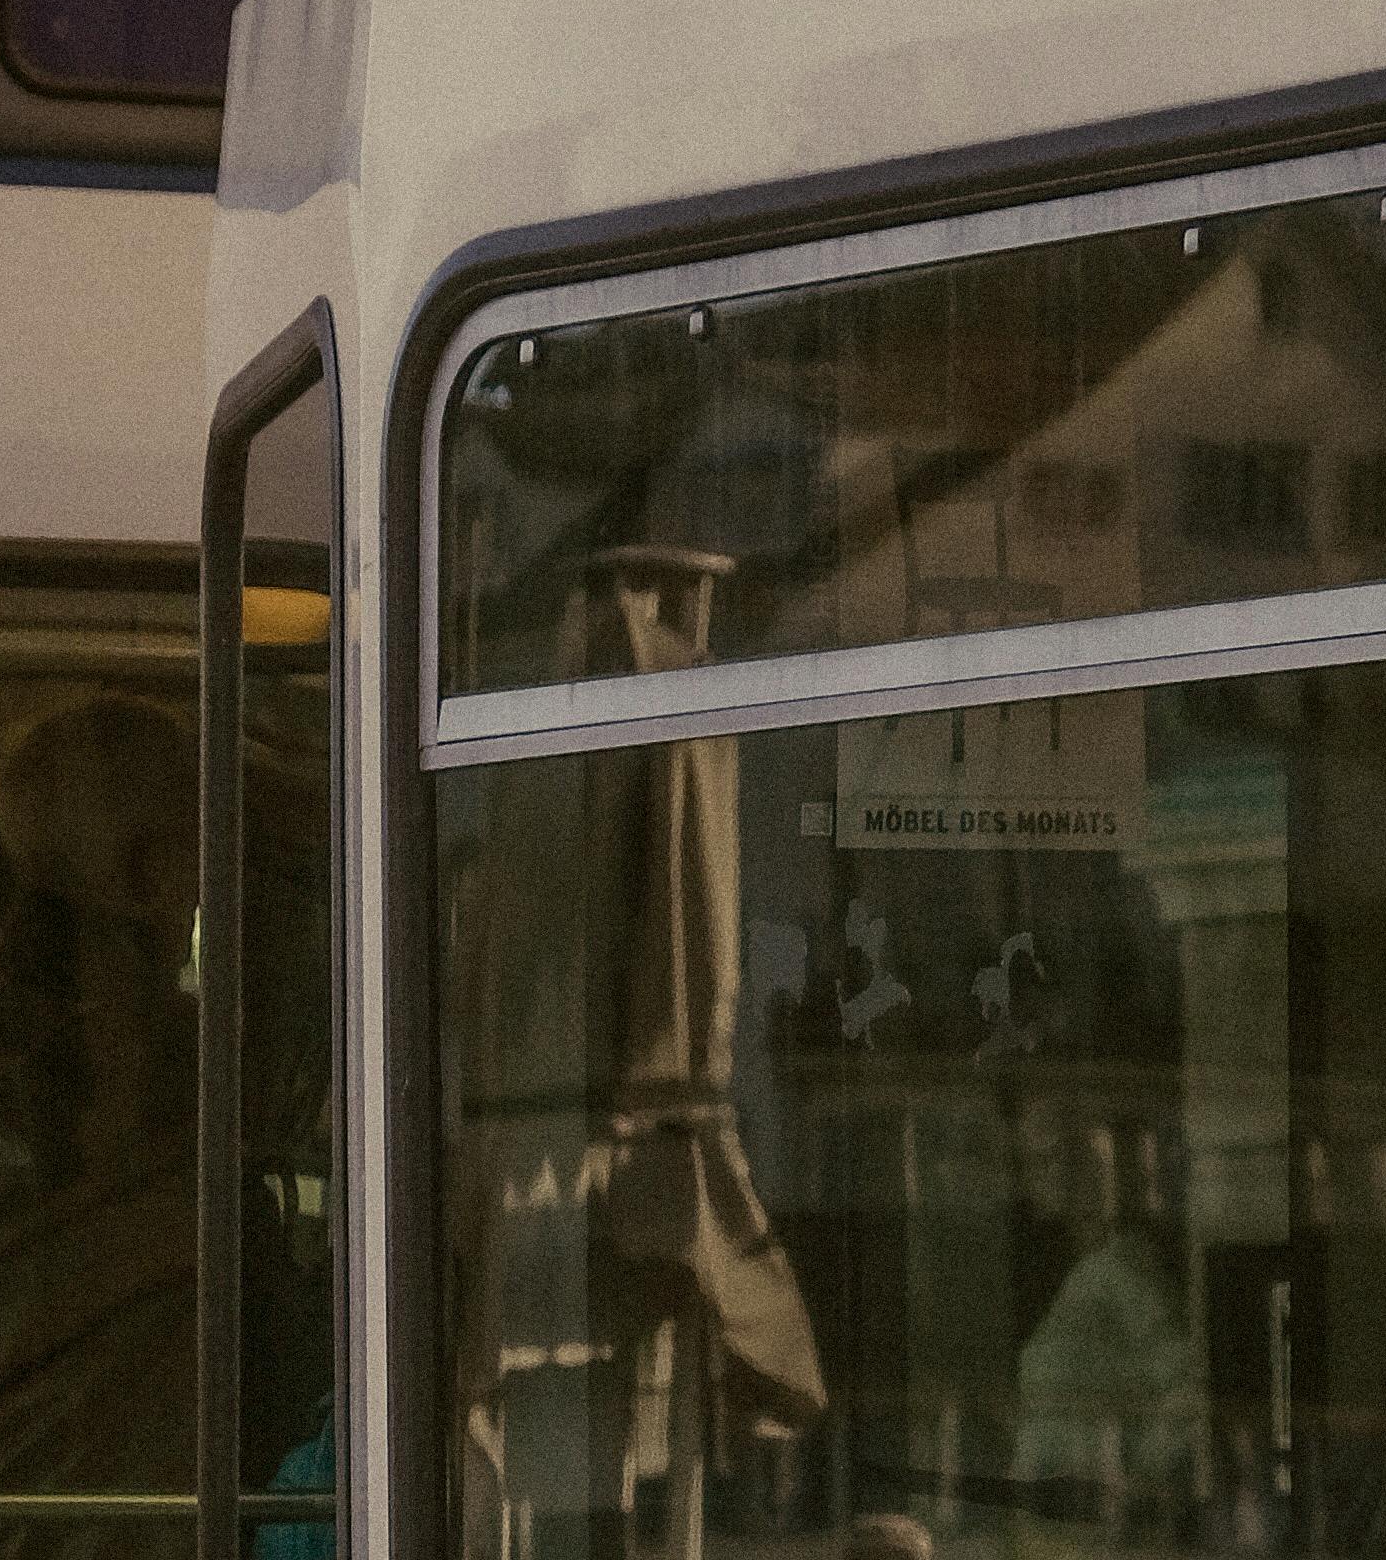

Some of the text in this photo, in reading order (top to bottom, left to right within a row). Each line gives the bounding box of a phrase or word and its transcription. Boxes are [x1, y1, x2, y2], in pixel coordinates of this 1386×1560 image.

[865, 803, 1116, 835] MÖBEL DES MONATS
